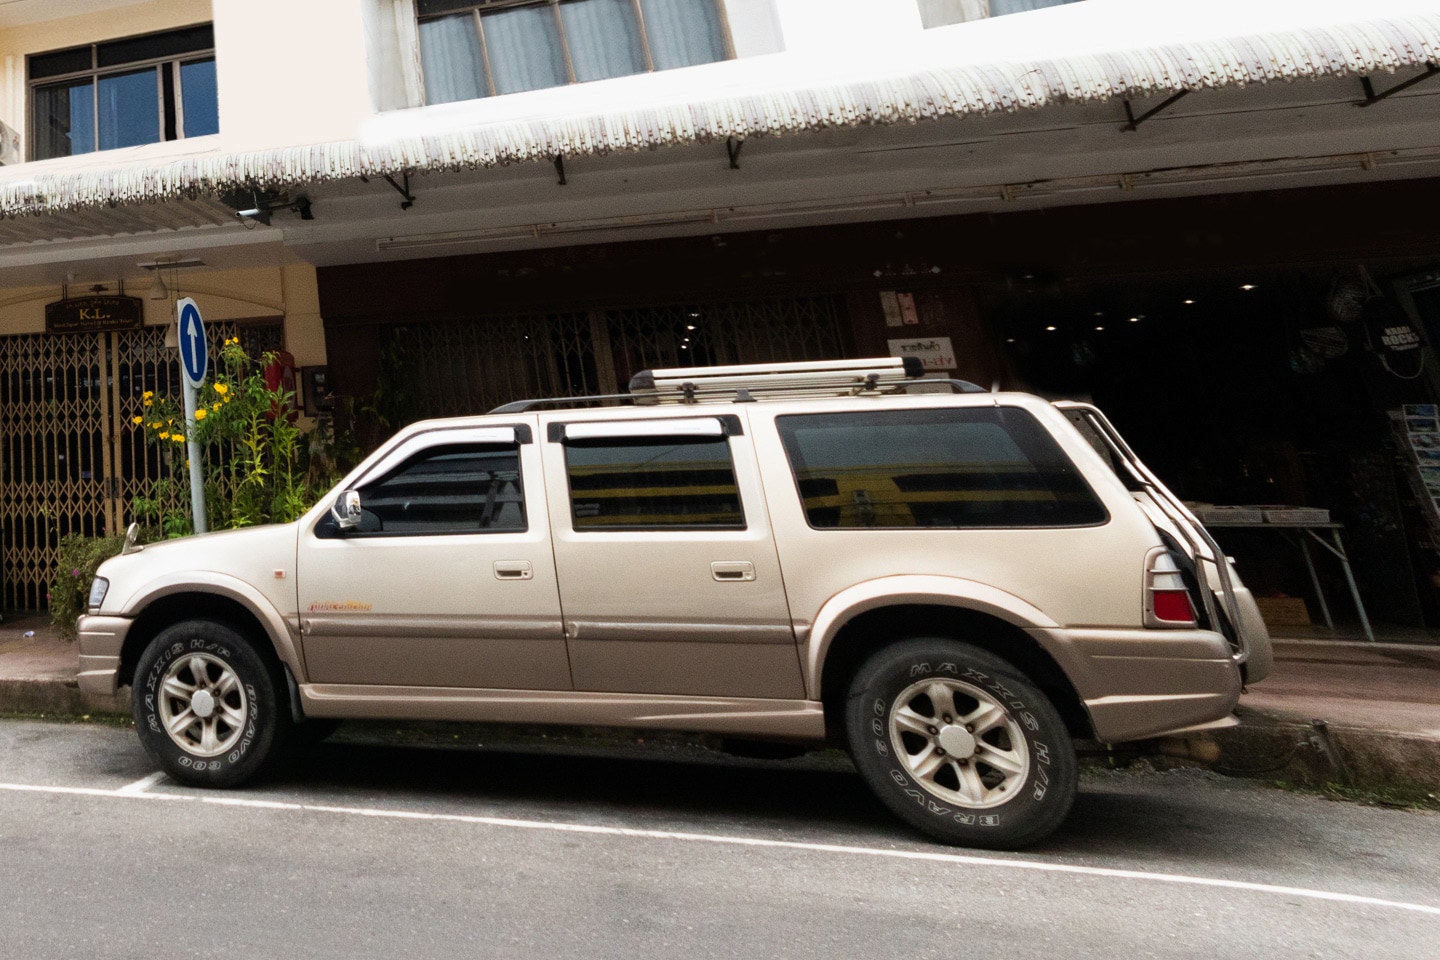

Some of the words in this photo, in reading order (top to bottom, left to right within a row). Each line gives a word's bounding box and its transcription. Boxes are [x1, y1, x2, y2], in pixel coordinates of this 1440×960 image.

[79, 308, 111, 320] K.L.
[145, 642, 184, 733] MAXXIS
[910, 662, 1039, 731] MAXXIS
[228, 684, 258, 764] BRAVO
[890, 769, 1000, 826] BRAVO
